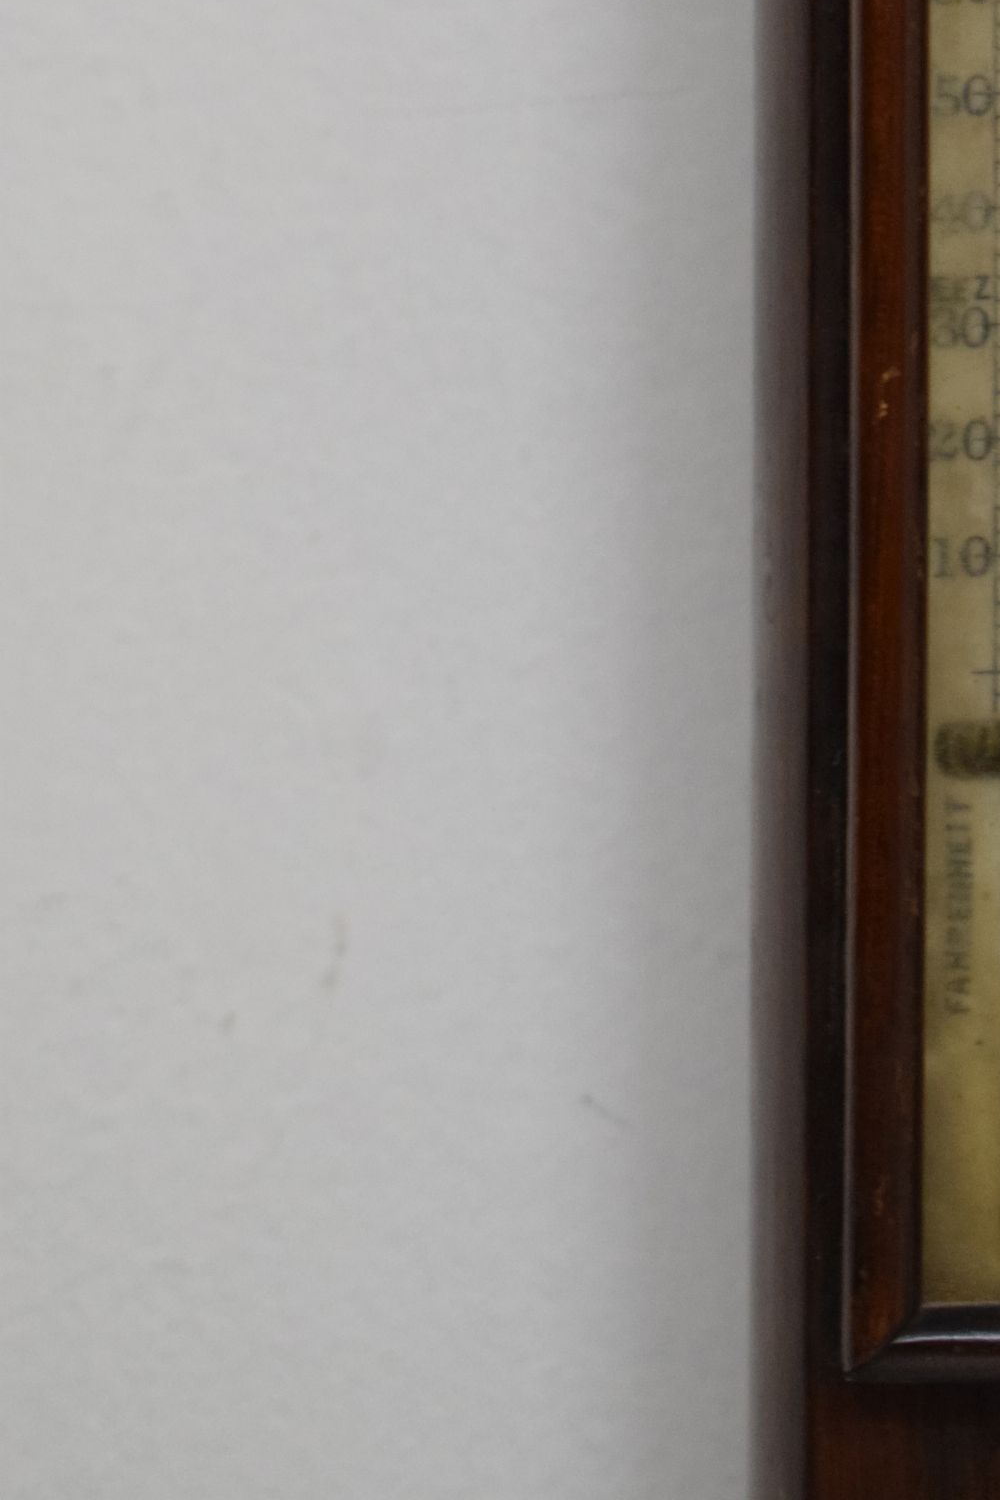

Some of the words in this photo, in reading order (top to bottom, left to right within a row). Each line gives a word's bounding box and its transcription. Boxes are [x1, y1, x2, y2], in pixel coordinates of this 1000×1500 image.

[933, 73, 994, 118] 50
[931, 306, 991, 349] 30
[930, 419, 993, 461] 20
[933, 535, 993, 579] 10
[945, 794, 973, 1016] FAHRENHEIT
